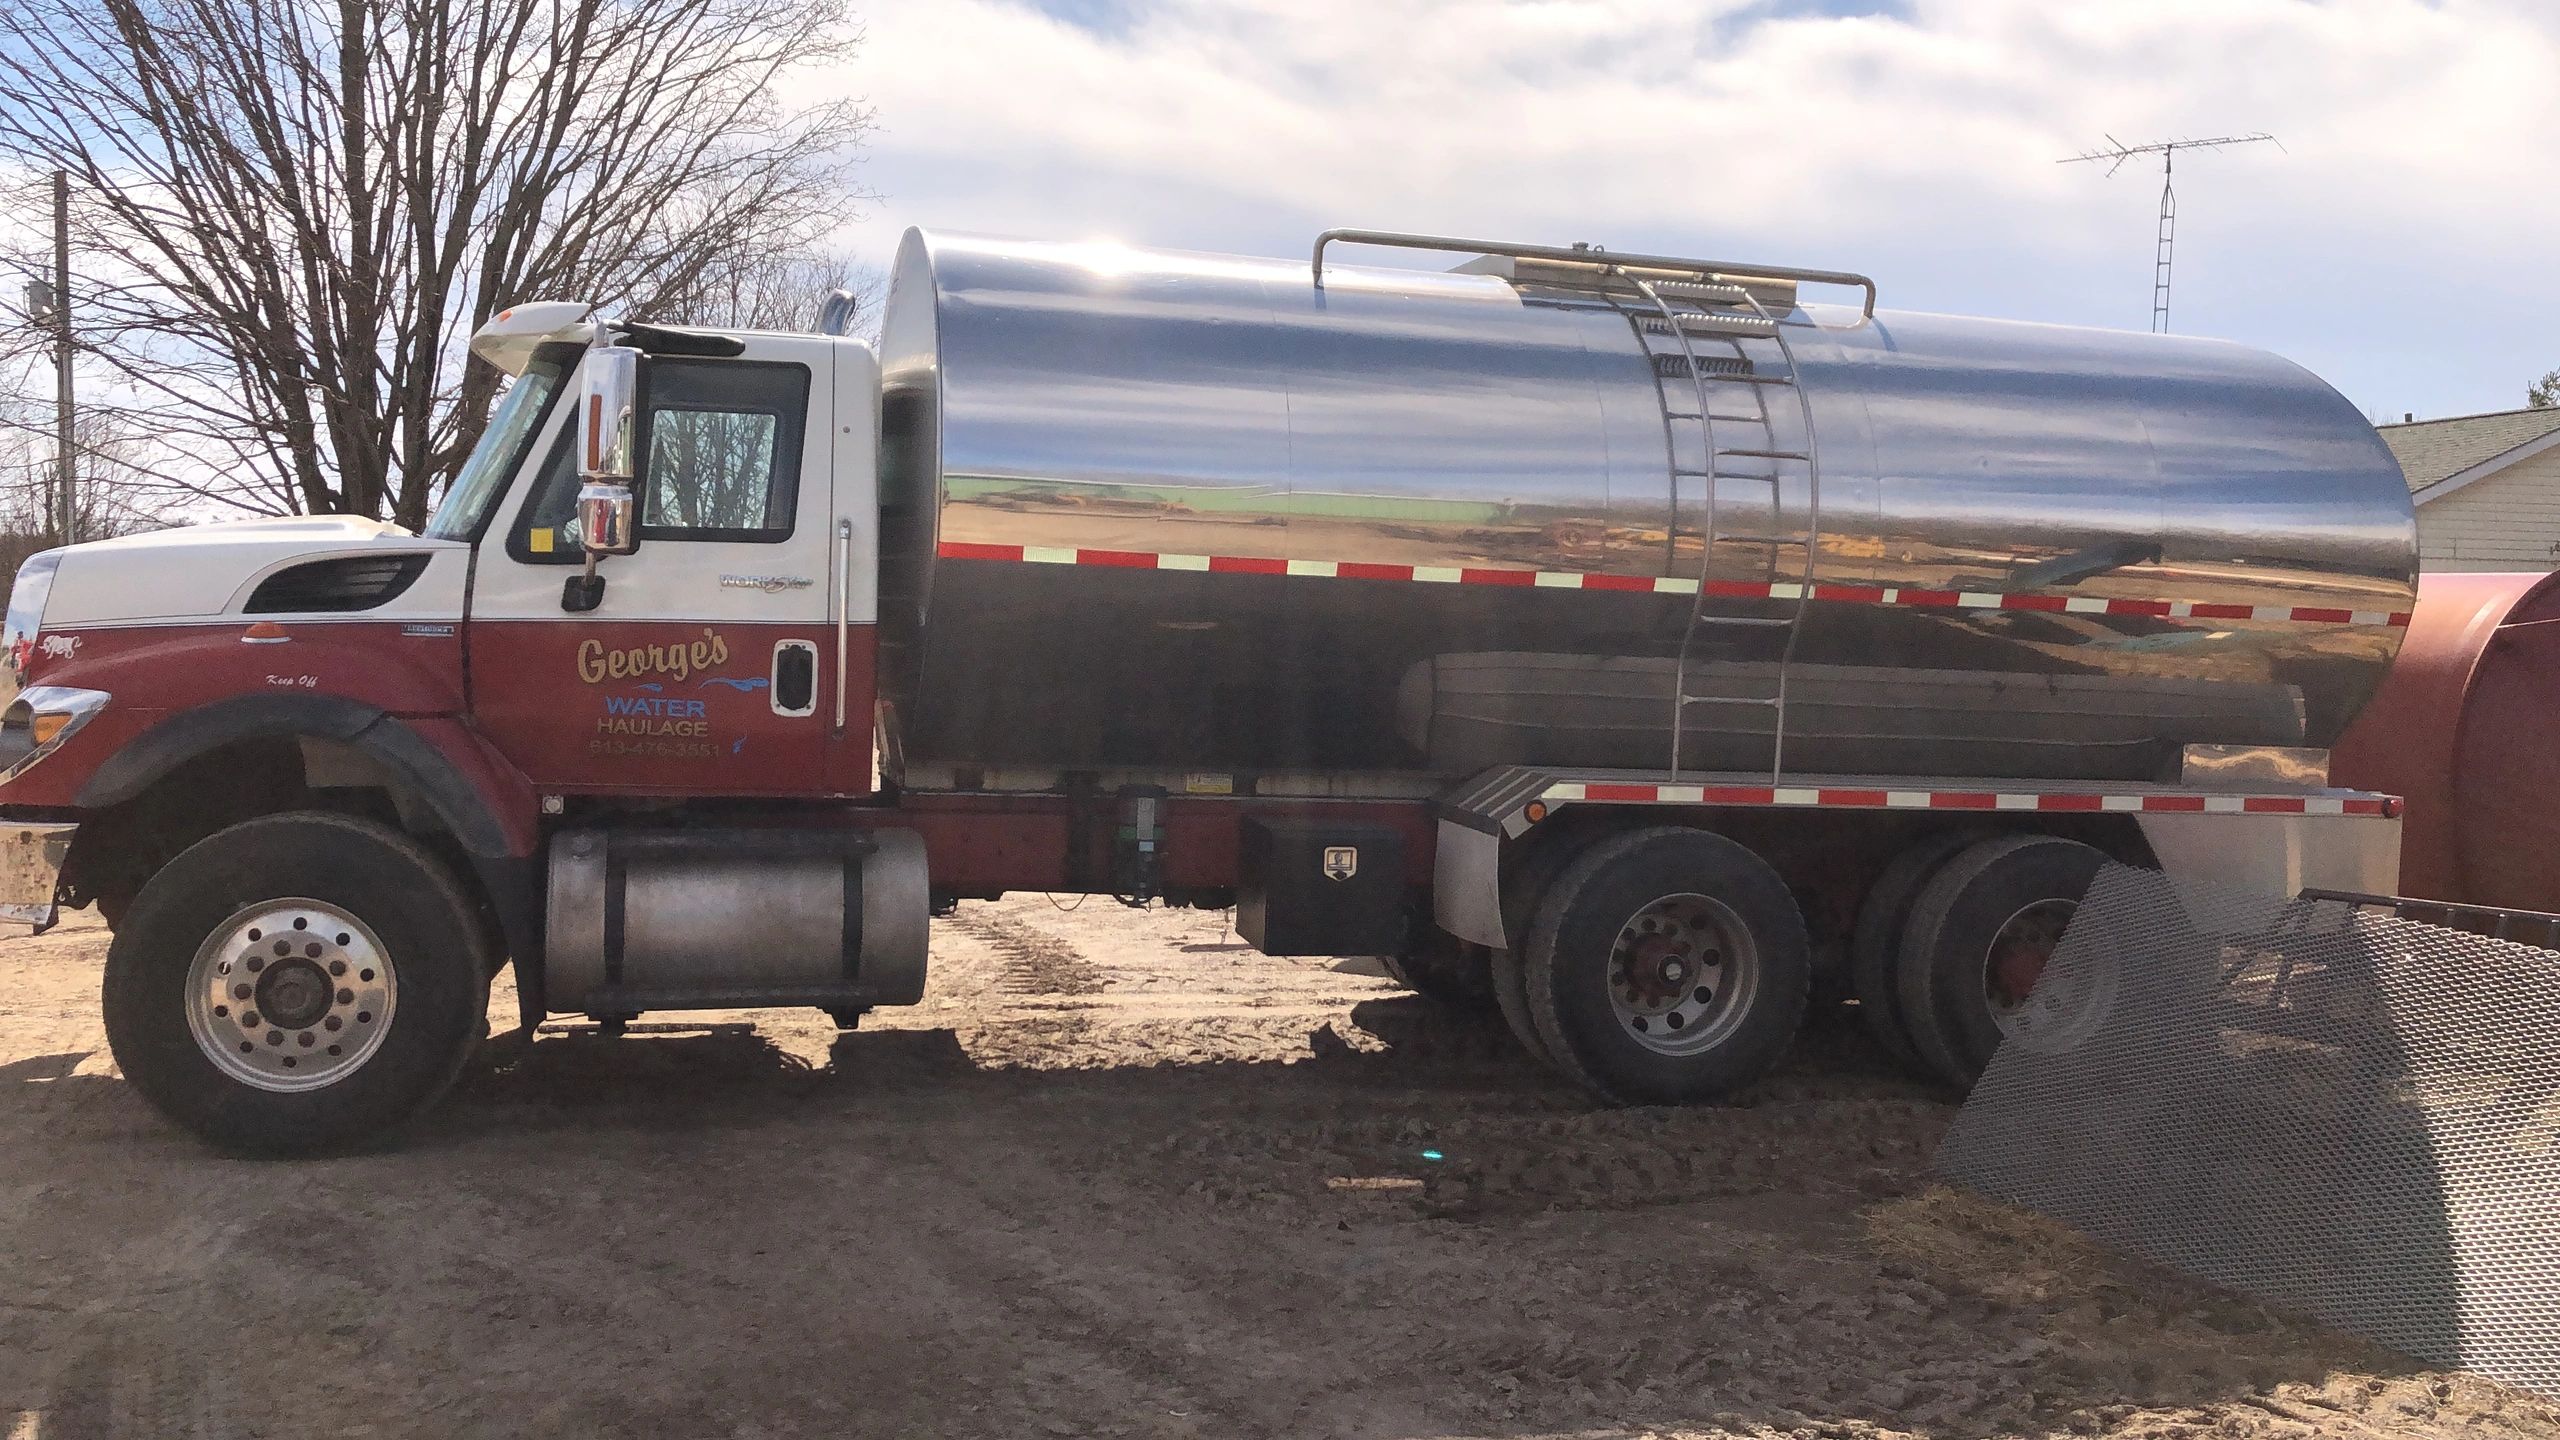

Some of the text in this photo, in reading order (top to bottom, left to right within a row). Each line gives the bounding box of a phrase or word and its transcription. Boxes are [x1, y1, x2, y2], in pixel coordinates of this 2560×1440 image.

[577, 627, 728, 683] George's
[265, 674, 318, 688] Keep Off
[605, 695, 706, 718] WATER
[597, 718, 709, 737] HAULAGE
